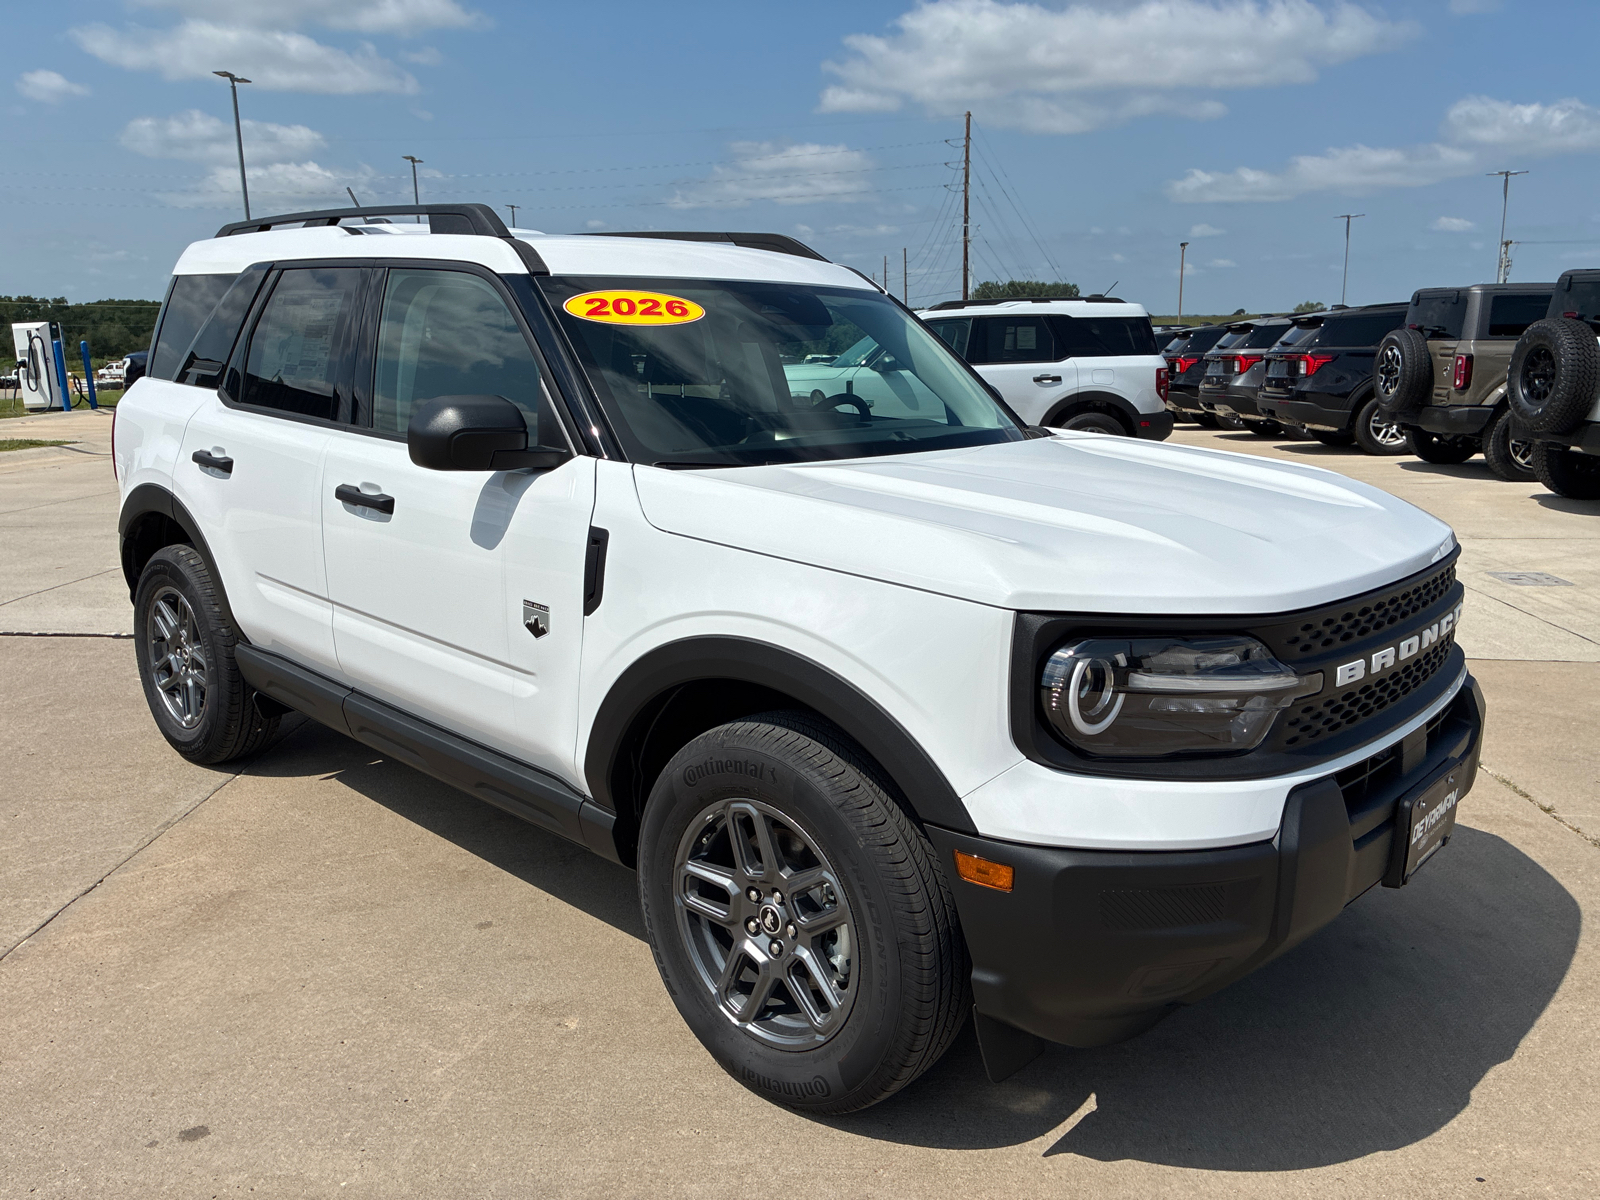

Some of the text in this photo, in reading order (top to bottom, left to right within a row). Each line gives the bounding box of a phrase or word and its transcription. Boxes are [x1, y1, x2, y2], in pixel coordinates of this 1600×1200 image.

[584, 298, 690, 317] 2026
[1336, 602, 1463, 688] BRONCO
[682, 756, 765, 787] Continental
[1411, 787, 1460, 846] DEYARMAN
[741, 1065, 832, 1100] Continental
